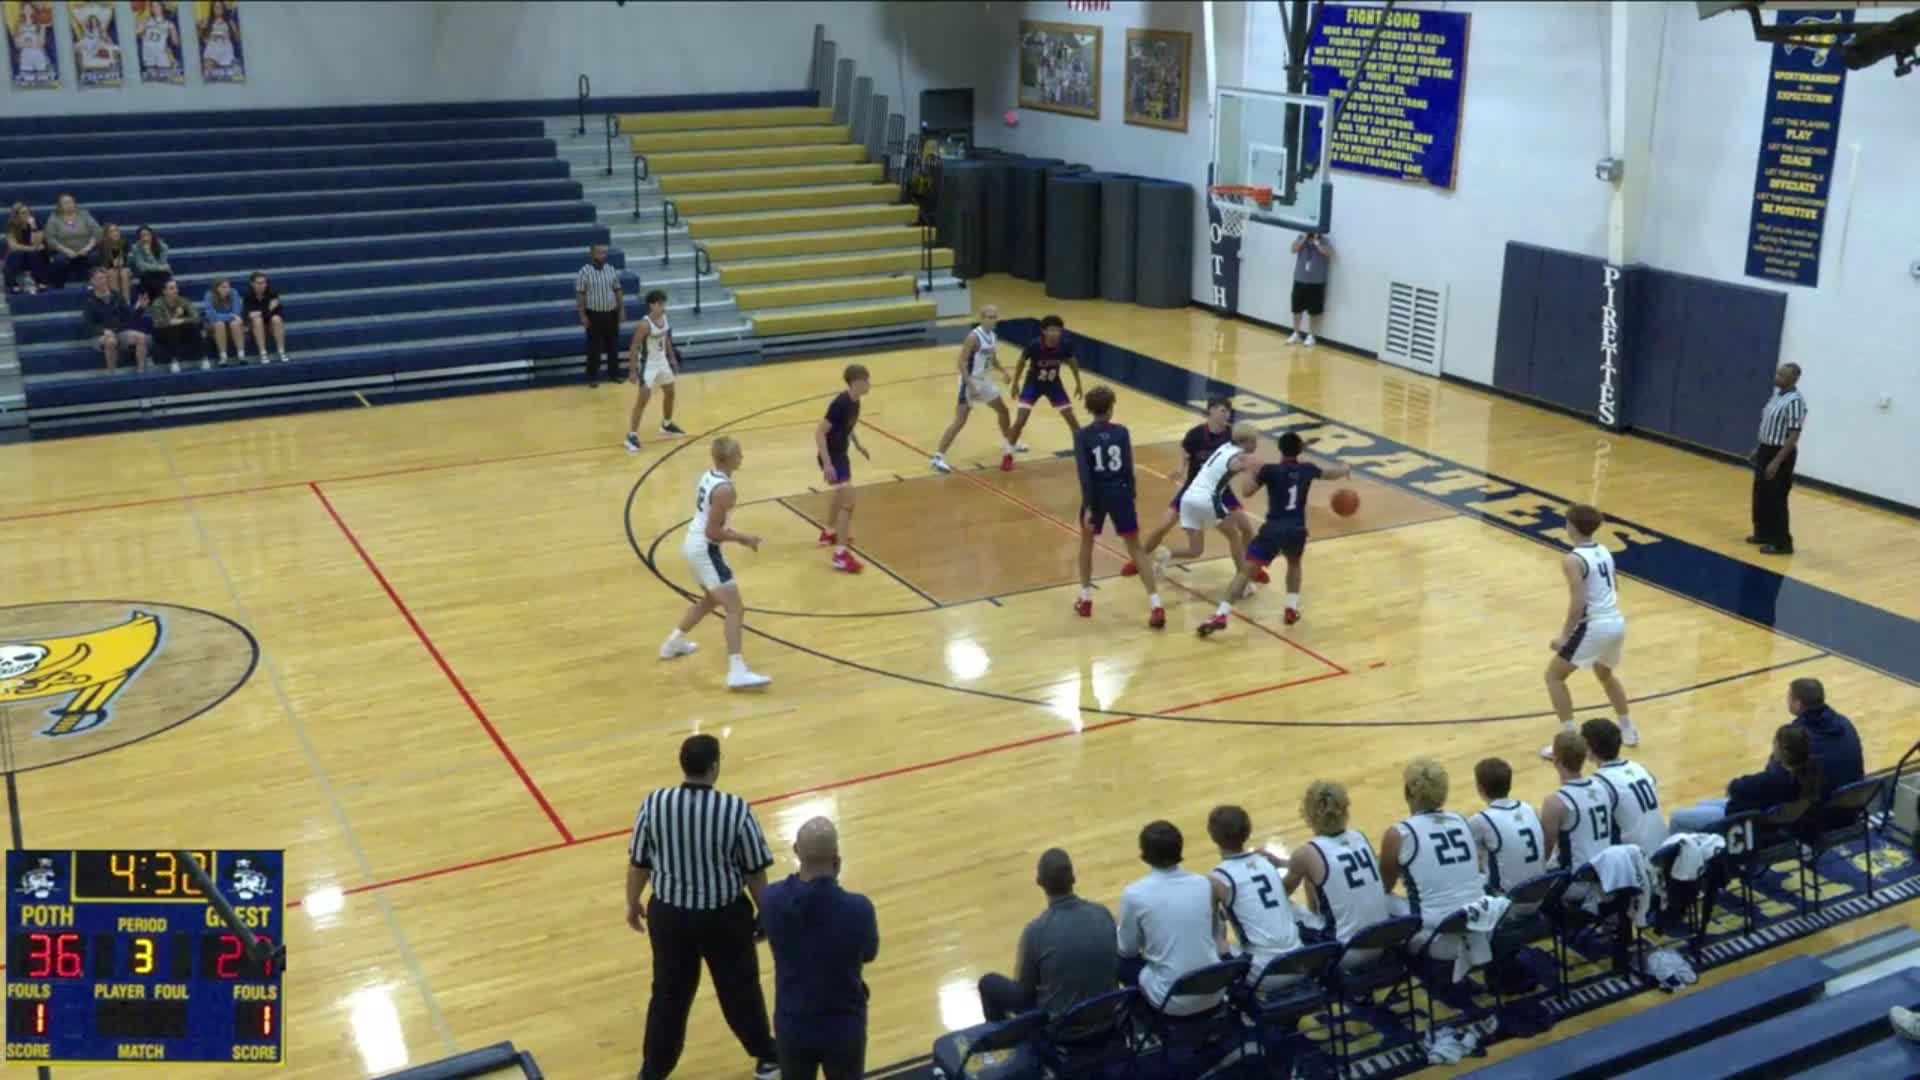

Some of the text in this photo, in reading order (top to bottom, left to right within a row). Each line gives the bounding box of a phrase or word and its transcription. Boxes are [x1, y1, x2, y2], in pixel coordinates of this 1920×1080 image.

[1347, 8, 1420, 29] FIGHT SONG
[1785, 127, 1814, 140] PLAY
[1780, 154, 1812, 167] COACH
[1599, 266, 1620, 425] PIRETTES
[1092, 444, 1123, 472] 13
[1284, 484, 1298, 510] 1
[1598, 561, 1612, 588] 4
[1628, 778, 1658, 814] 10
[1589, 805, 1610, 841] 13
[1429, 828, 1471, 867] 25
[1519, 828, 1539, 864] 3
[1337, 848, 1380, 889] 24
[1252, 874, 1279, 909] 2
